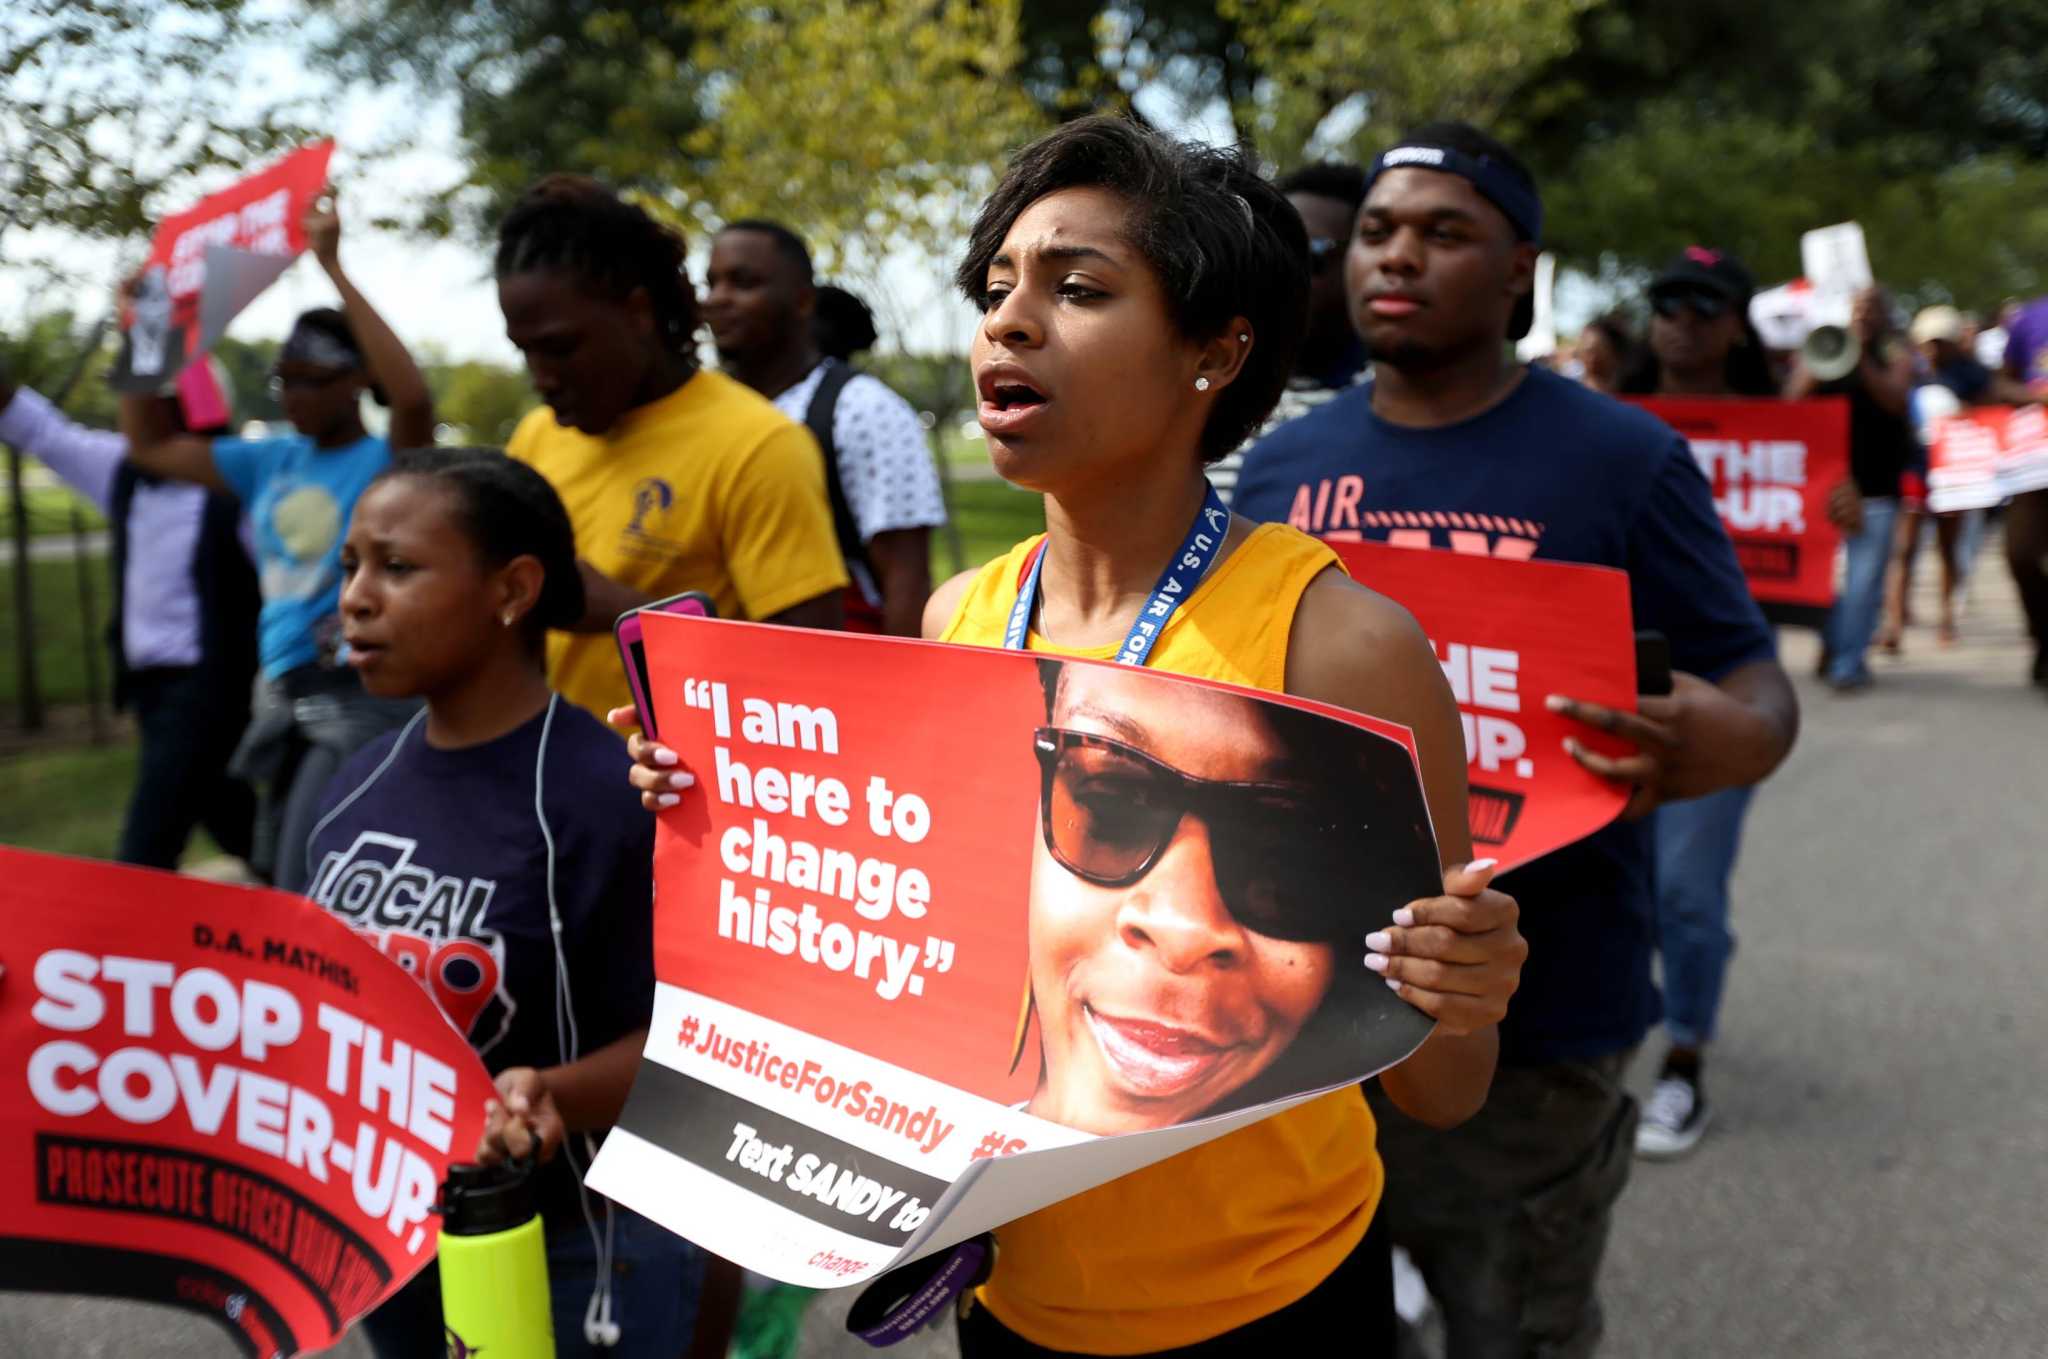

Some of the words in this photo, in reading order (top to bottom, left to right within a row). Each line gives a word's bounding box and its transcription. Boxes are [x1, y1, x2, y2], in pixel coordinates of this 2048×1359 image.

[1287, 474, 1364, 532] AIR
[1177, 532, 1213, 571] U.S.
[1149, 576, 1183, 618] AIR
[742, 698, 838, 754] am
[714, 746, 850, 826] here
[866, 776, 931, 843] to
[308, 851, 497, 946] LOCAL
[720, 818, 931, 920] change
[194, 923, 253, 958] D.A.
[32, 949, 302, 1061] STOP
[318, 1003, 457, 1153] THE
[678, 1015, 954, 1154] #JusticeForSandy
[47, 1145, 205, 1213] PROSECUTE
[725, 1121, 794, 1182] Text
[786, 1153, 906, 1222] SANDY
[889, 1197, 930, 1232] to
